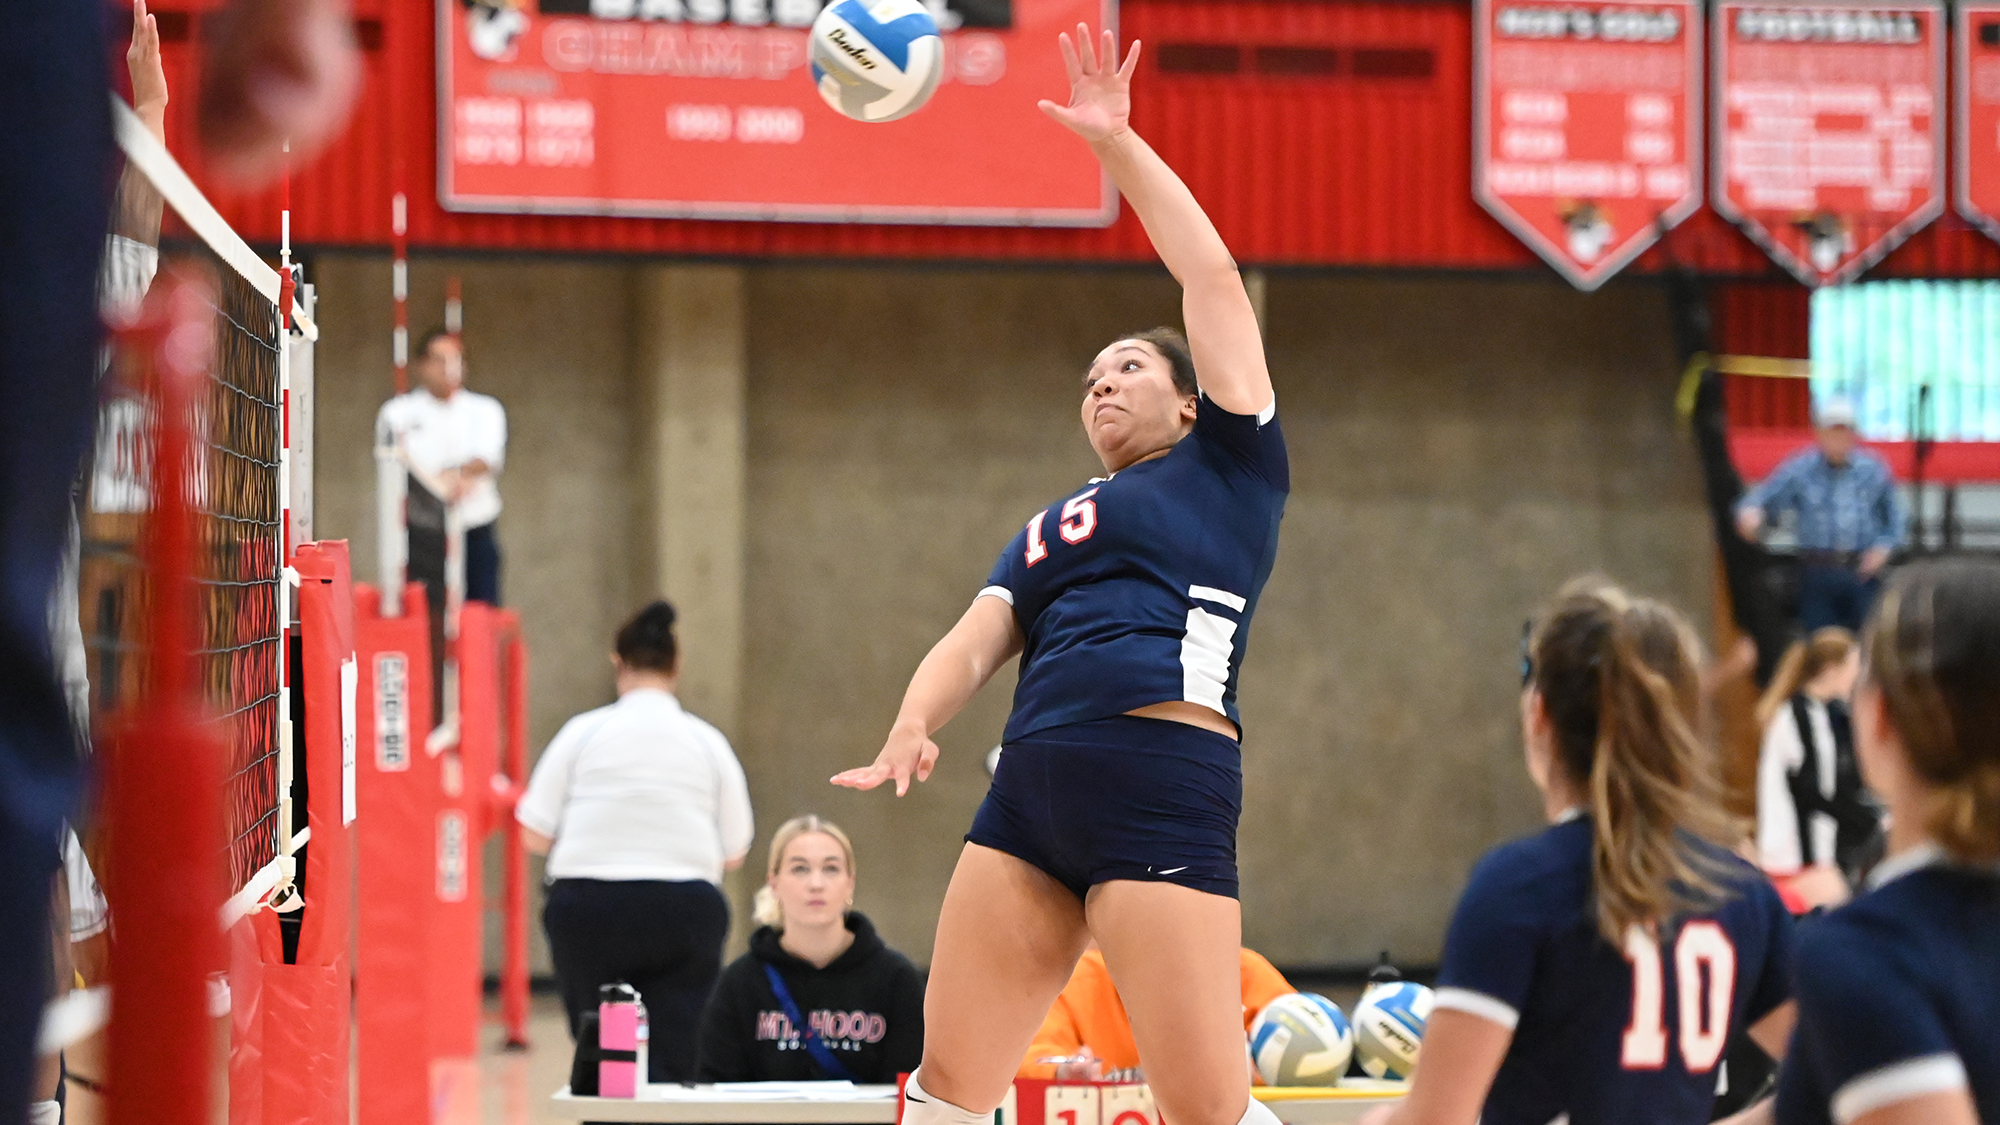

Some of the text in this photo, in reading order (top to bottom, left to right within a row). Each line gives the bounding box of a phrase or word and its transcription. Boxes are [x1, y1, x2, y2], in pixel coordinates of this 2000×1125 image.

[827, 28, 877, 70] Baden
[1024, 486, 1100, 569] 15
[807, 1010, 886, 1043] HOOD
[1620, 920, 1738, 1073] 10
